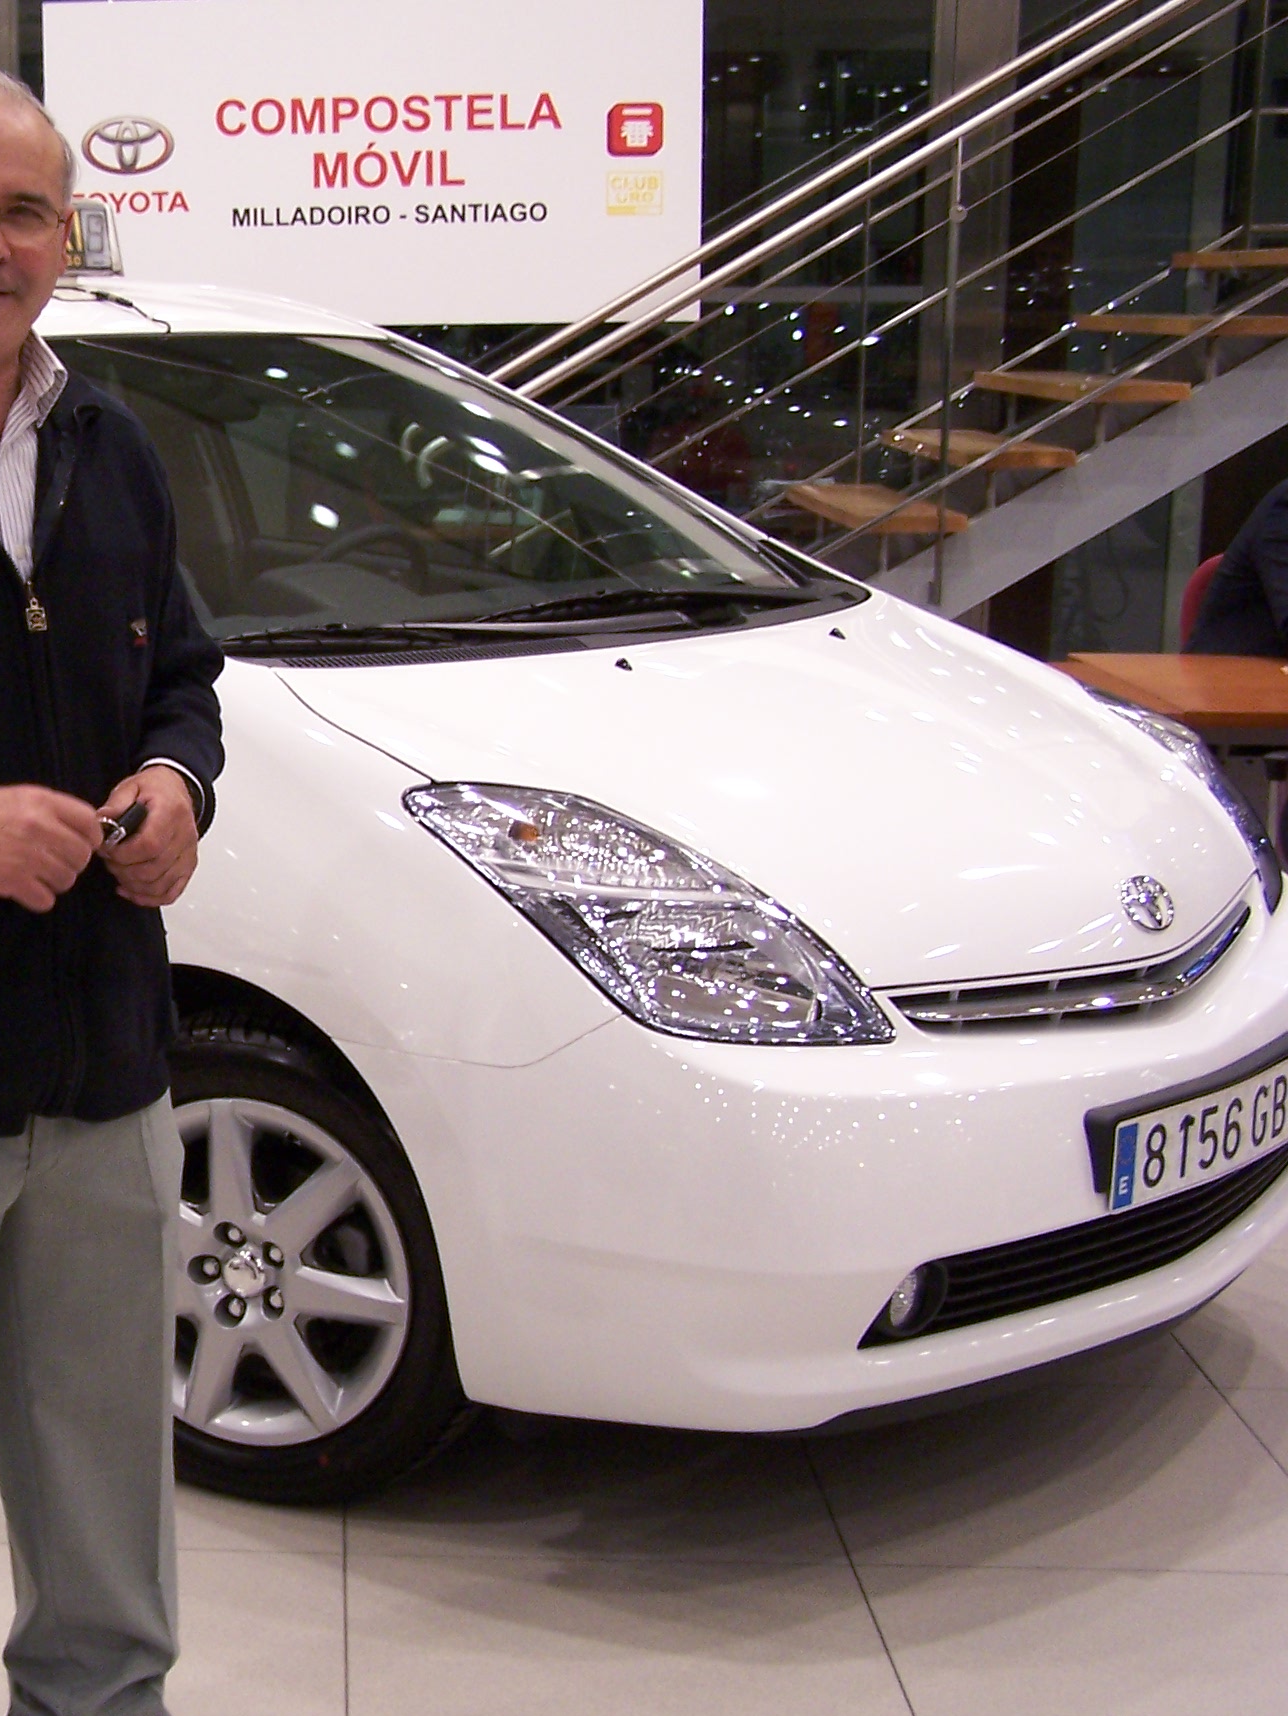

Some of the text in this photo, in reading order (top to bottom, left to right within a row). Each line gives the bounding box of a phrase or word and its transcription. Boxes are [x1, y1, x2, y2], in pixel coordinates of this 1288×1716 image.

[215, 92, 562, 136] COMPOSTELA
[313, 141, 466, 188] MÓVIL
[72, 190, 190, 213] YOTA
[231, 205, 391, 227] MILLADOIRO
[414, 202, 548, 224] SANTIAGO
[1118, 1175, 1129, 1196] E
[1142, 1097, 1244, 1188] 8156
